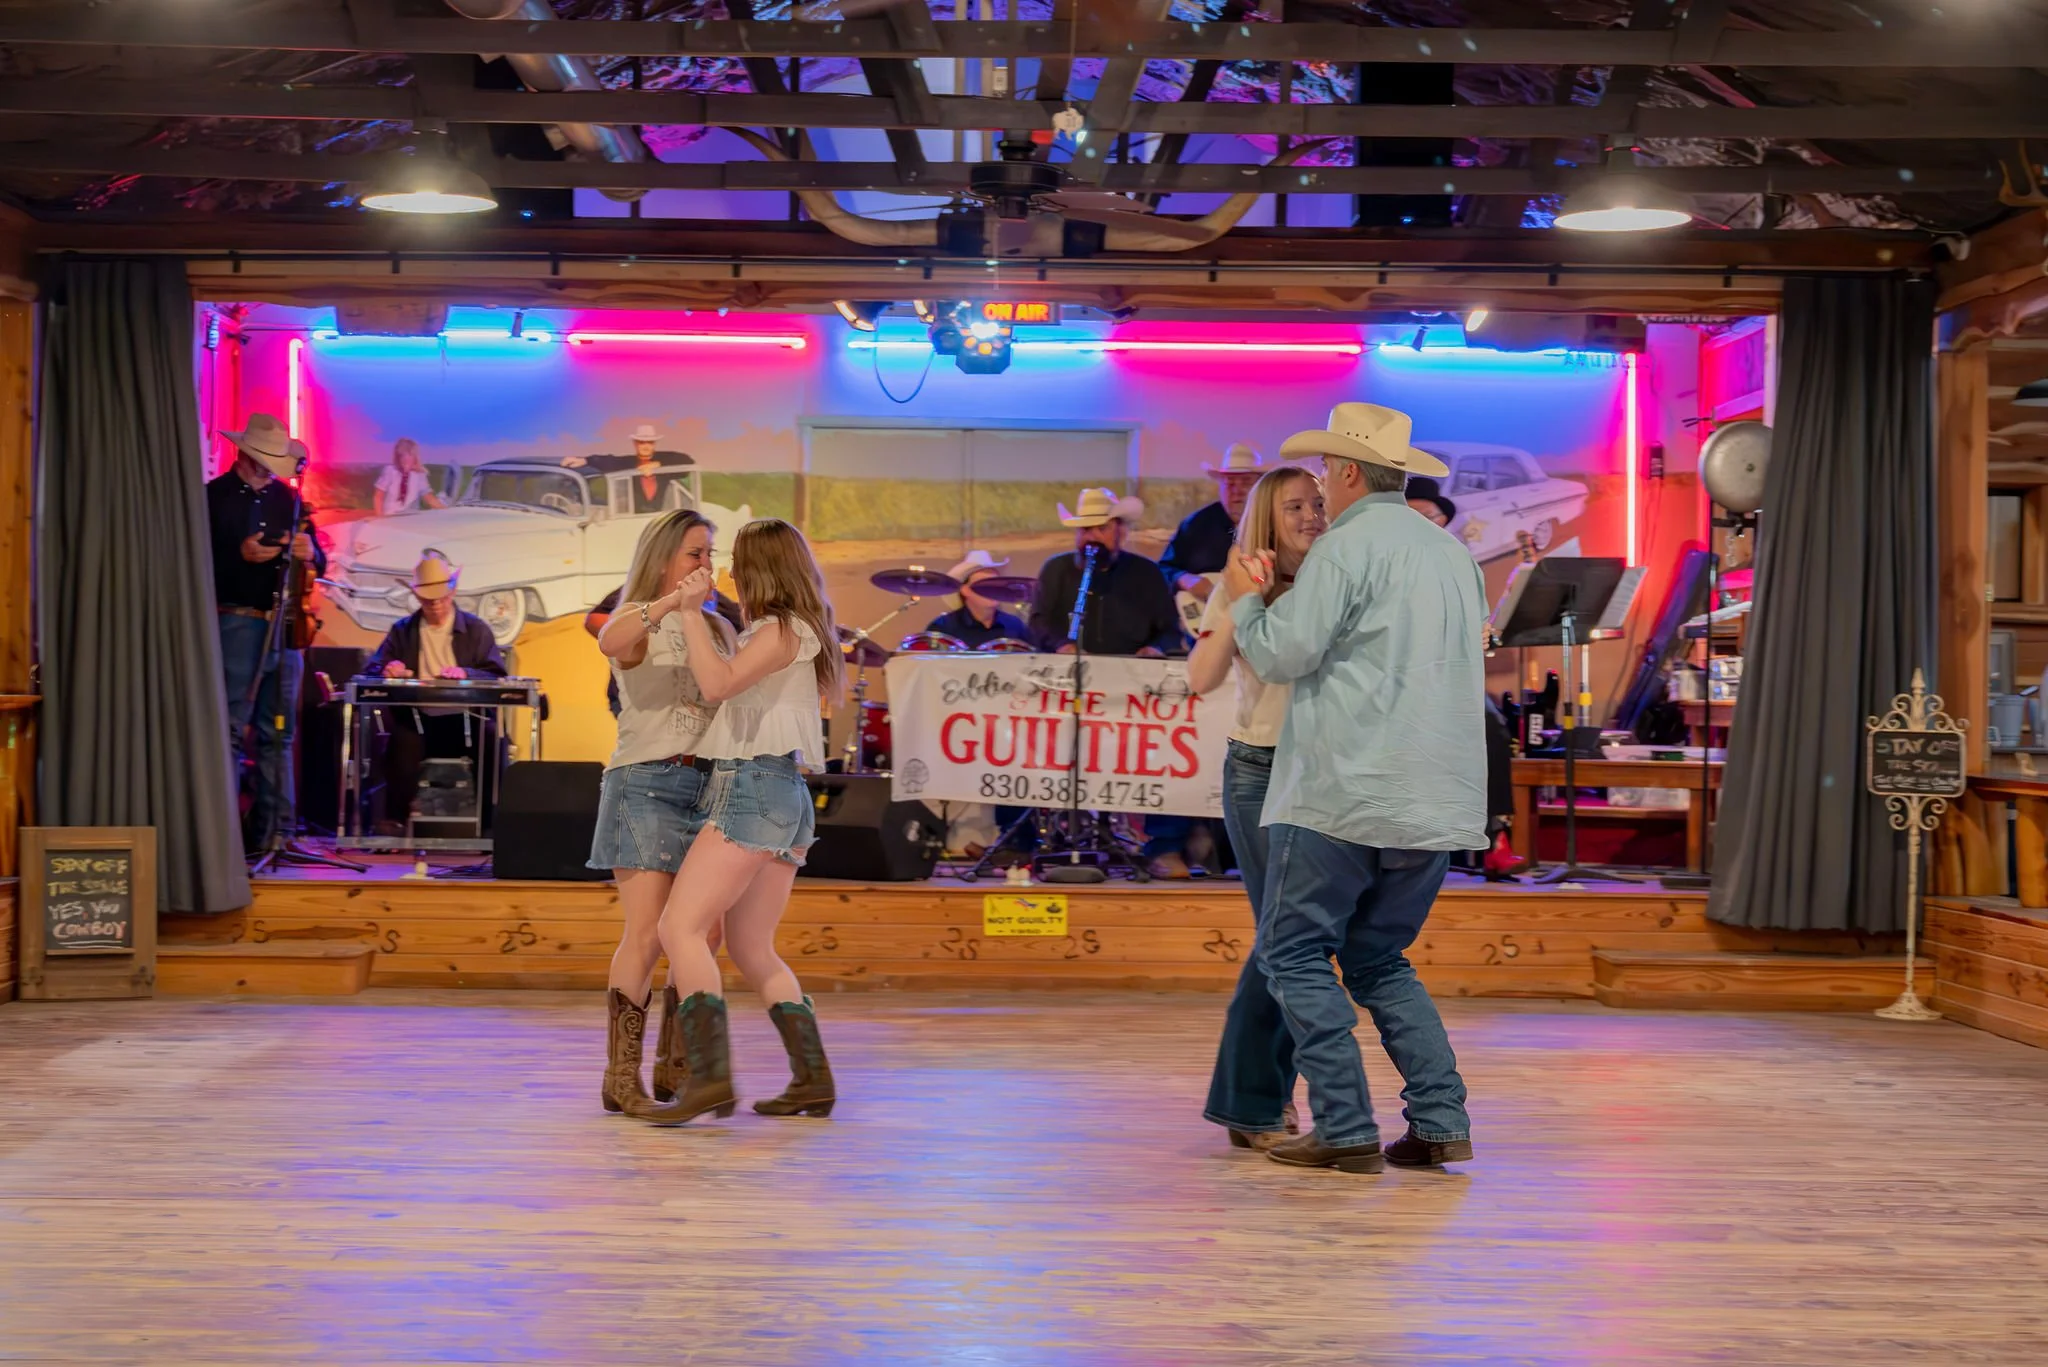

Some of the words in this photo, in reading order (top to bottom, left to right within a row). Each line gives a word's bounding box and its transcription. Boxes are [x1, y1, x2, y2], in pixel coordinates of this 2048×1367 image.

[984, 304, 1013, 320] ON
[1016, 303, 1049, 320] AIR
[1038, 690, 1106, 716] THE
[1124, 693, 1204, 723] NOT
[940, 712, 1199, 778] GUILTIES
[1876, 739, 1925, 756] STAY
[1017, 916, 1064, 924] GUILTY
[1480, 935, 1521, 966] 25
